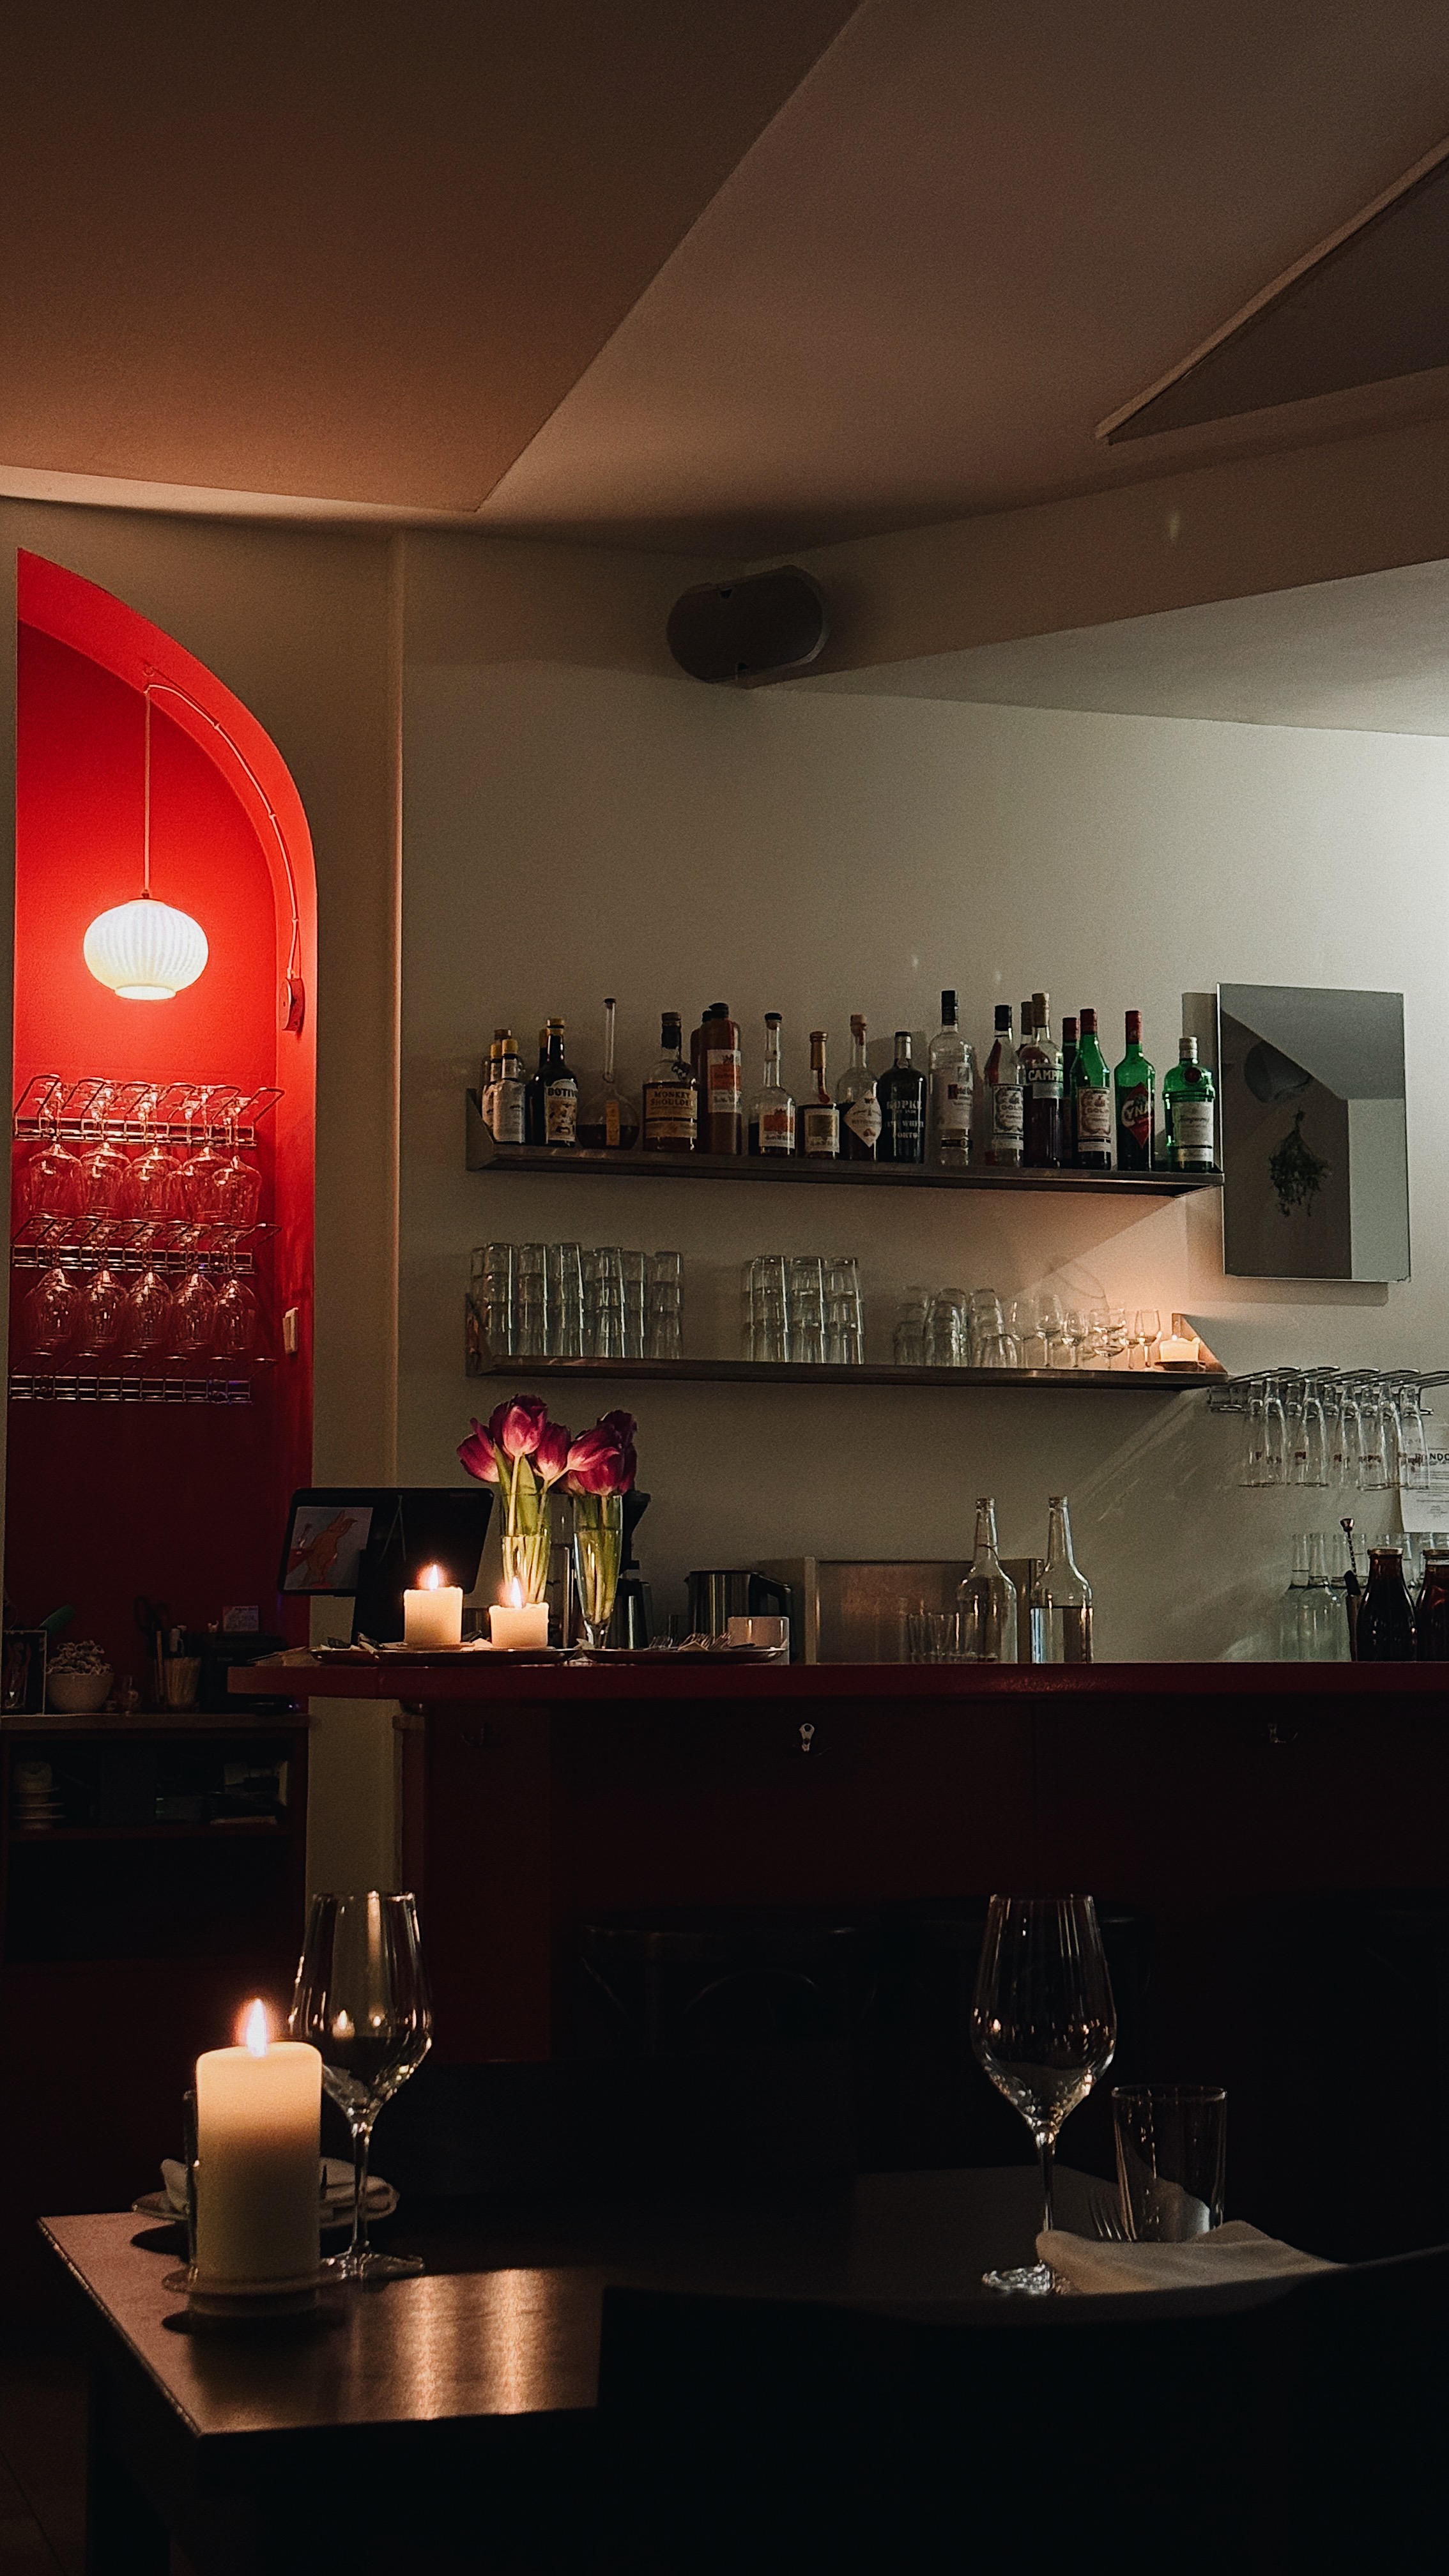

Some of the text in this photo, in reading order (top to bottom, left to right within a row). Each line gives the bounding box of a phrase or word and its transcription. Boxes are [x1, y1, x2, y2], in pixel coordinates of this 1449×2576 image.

[1028, 1070, 1062, 1082] CAMP
[650, 1098, 693, 1106] SHOULDE
[1121, 1099, 1154, 1128] CYNA
